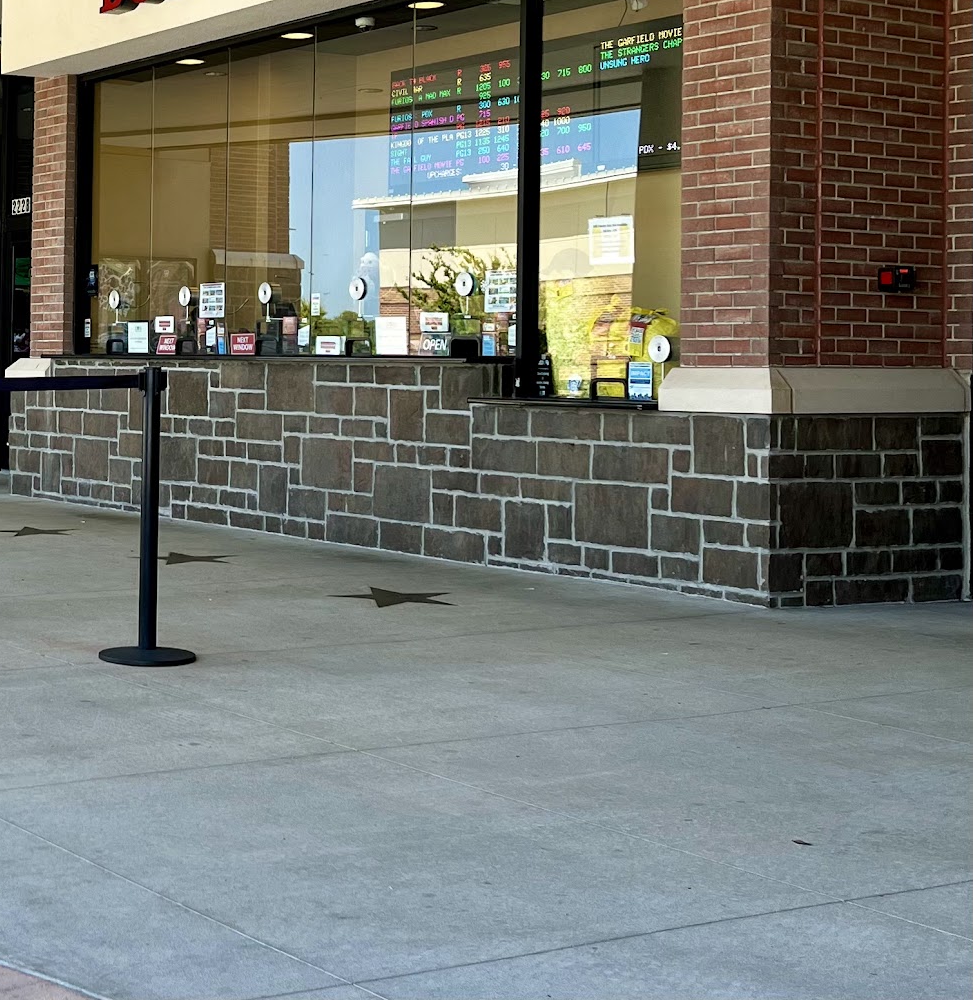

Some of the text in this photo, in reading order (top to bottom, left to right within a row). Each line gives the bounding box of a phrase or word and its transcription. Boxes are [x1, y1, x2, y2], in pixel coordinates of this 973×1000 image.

[600, 38, 683, 60] THE STRANGERS CHAP
[601, 27, 683, 50] THE GARFIELD MOVIE
[599, 53, 651, 70] UNSUNG HERO
[391, 96, 413, 106] FURIOS
[425, 92, 437, 100] MAD
[439, 89, 451, 98] MAX
[457, 87, 462, 95] R
[475, 81, 491, 92] 1205
[498, 78, 511, 88] 100
[557, 67, 571, 78] 715
[577, 63, 593, 74] 800
[391, 88, 408, 98] CIVIL
[457, 78, 462, 86] R
[391, 113, 413, 123] FURIOS
[457, 104, 462, 113] R
[497, 96, 511, 107] 630
[391, 120, 419, 132] GARFIED
[456, 113, 465, 122] PG
[478, 109, 491, 119] 715
[391, 139, 412, 149] KINGDO
[417, 137, 425, 146] OF
[428, 135, 439, 144] THE
[441, 133, 454, 142] PLA
[456, 130, 472, 140] PG13
[554, 115, 571, 126] 1000
[456, 139, 472, 149] PG13
[474, 136, 491, 147] 1135
[493, 134, 510, 144] 1245
[557, 126, 571, 135] 700
[390, 158, 401, 167] THE
[403, 156, 417, 165] FAL
[455, 149, 472, 158] PG13
[403, 162, 432, 174] GAFIELD
[433, 159, 453, 170] MOVIE
[456, 158, 465, 167] PG
[478, 155, 491, 164] 100
[556, 145, 571, 155] 610
[577, 142, 592, 152] 645
[638, 144, 654, 155] PDX
[233, 343, 254, 351] WINDOW
[422, 338, 448, 351] OPEN
